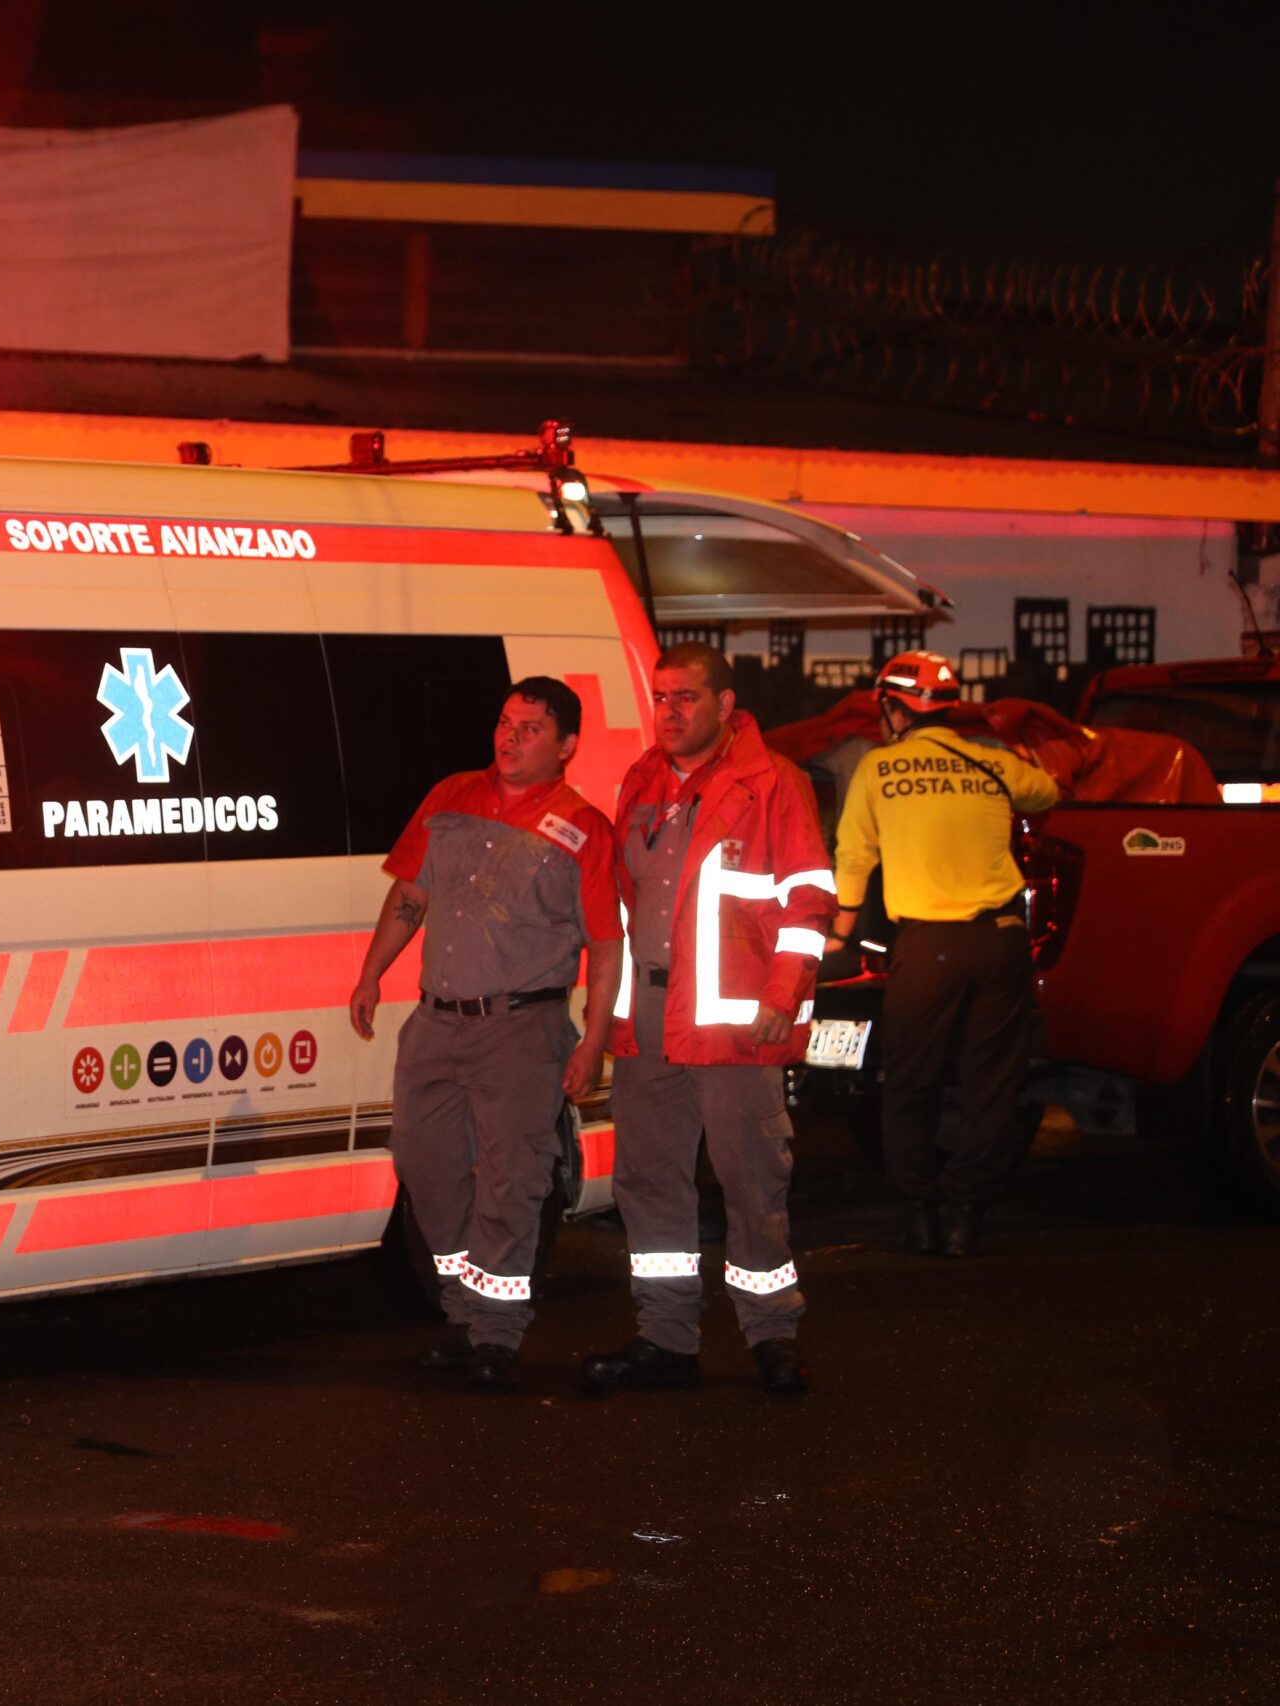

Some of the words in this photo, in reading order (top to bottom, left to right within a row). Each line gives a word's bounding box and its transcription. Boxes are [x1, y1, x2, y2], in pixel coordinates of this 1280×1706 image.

[5, 518, 155, 554] SOPORTE
[160, 524, 316, 559] AVANZADO
[877, 757, 1005, 777] BOMBEROS
[881, 778, 955, 799] COSTA
[42, 795, 279, 838] PARAMEDICOS
